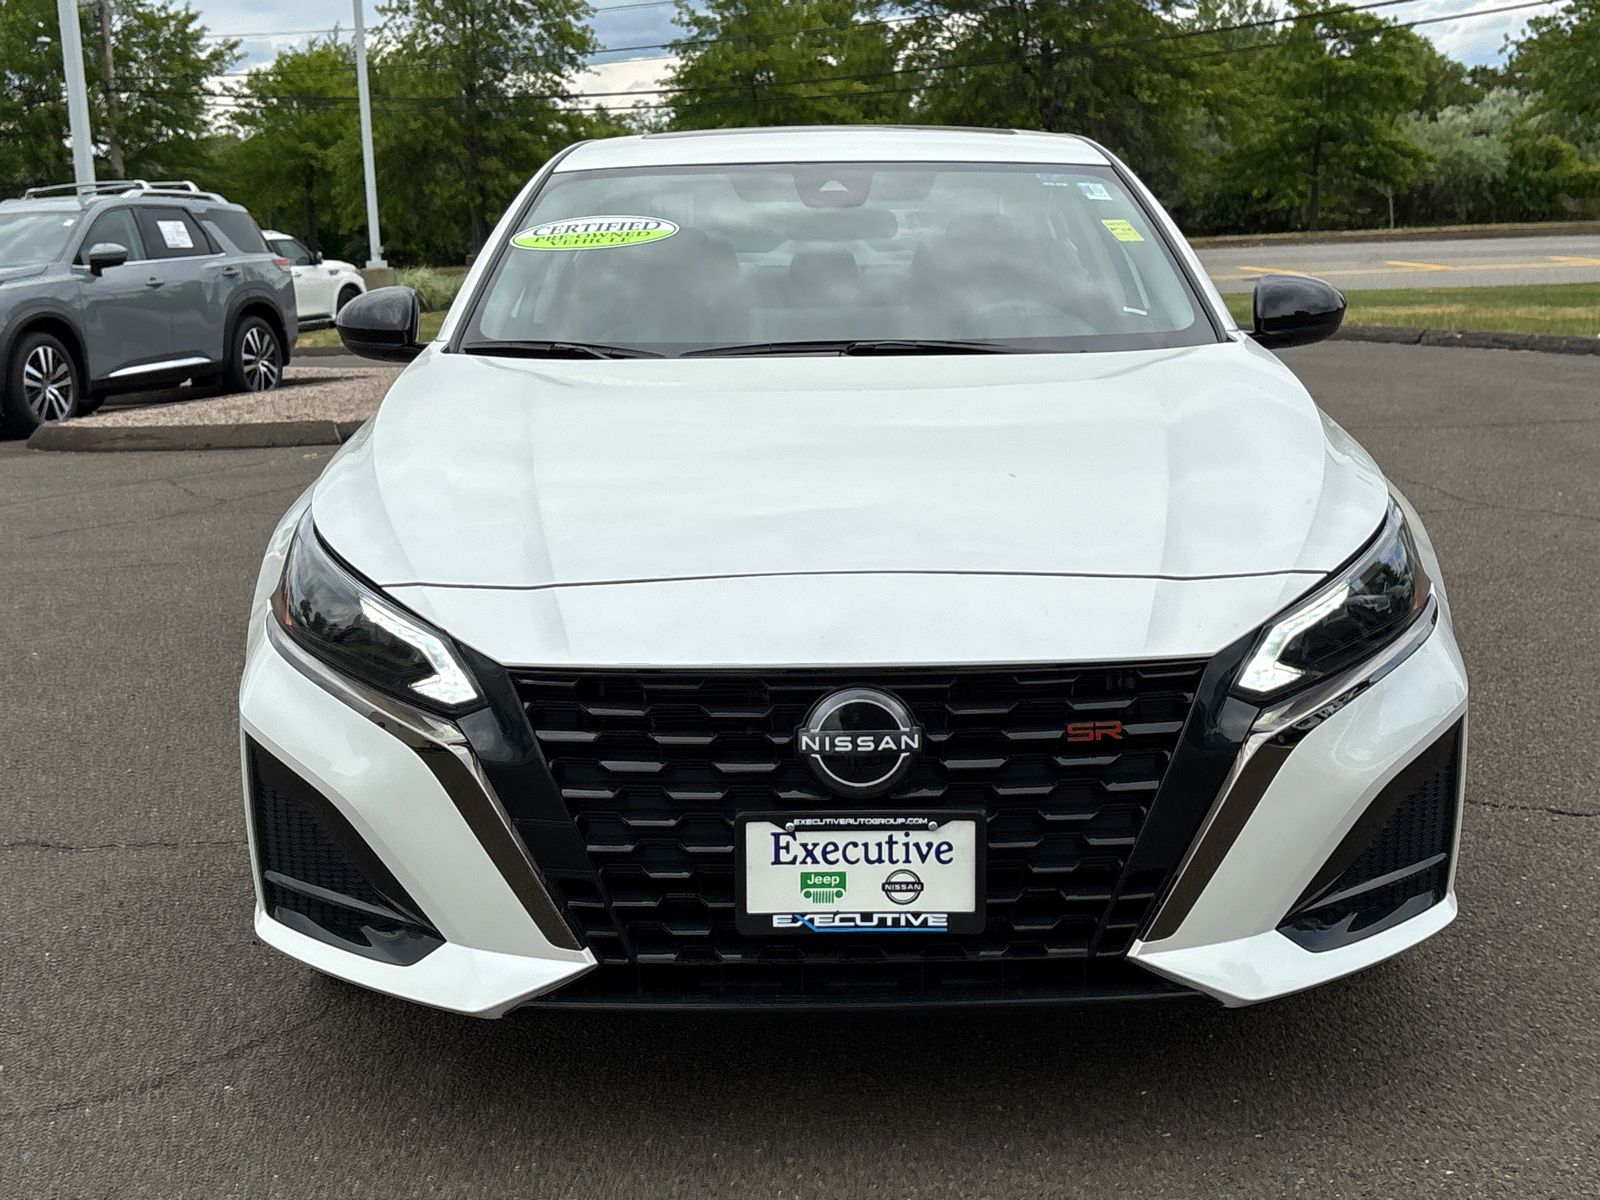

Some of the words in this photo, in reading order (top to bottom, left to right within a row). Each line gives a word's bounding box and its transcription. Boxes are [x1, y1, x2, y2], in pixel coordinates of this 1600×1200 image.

[532, 221, 661, 236] CERTIFIED
[534, 231, 651, 243] PRE-OWNED
[550, 237, 631, 246] VEHICLE
[1067, 721, 1123, 742] SR
[801, 733, 919, 752] NISSAN
[793, 817, 929, 826] EXECUTIVEAUTOGROUP.COM
[770, 831, 954, 866] Executive
[807, 873, 840, 886] Jeep
[884, 883, 922, 891] NISSAN
[772, 913, 948, 931] EXECUTIVE
